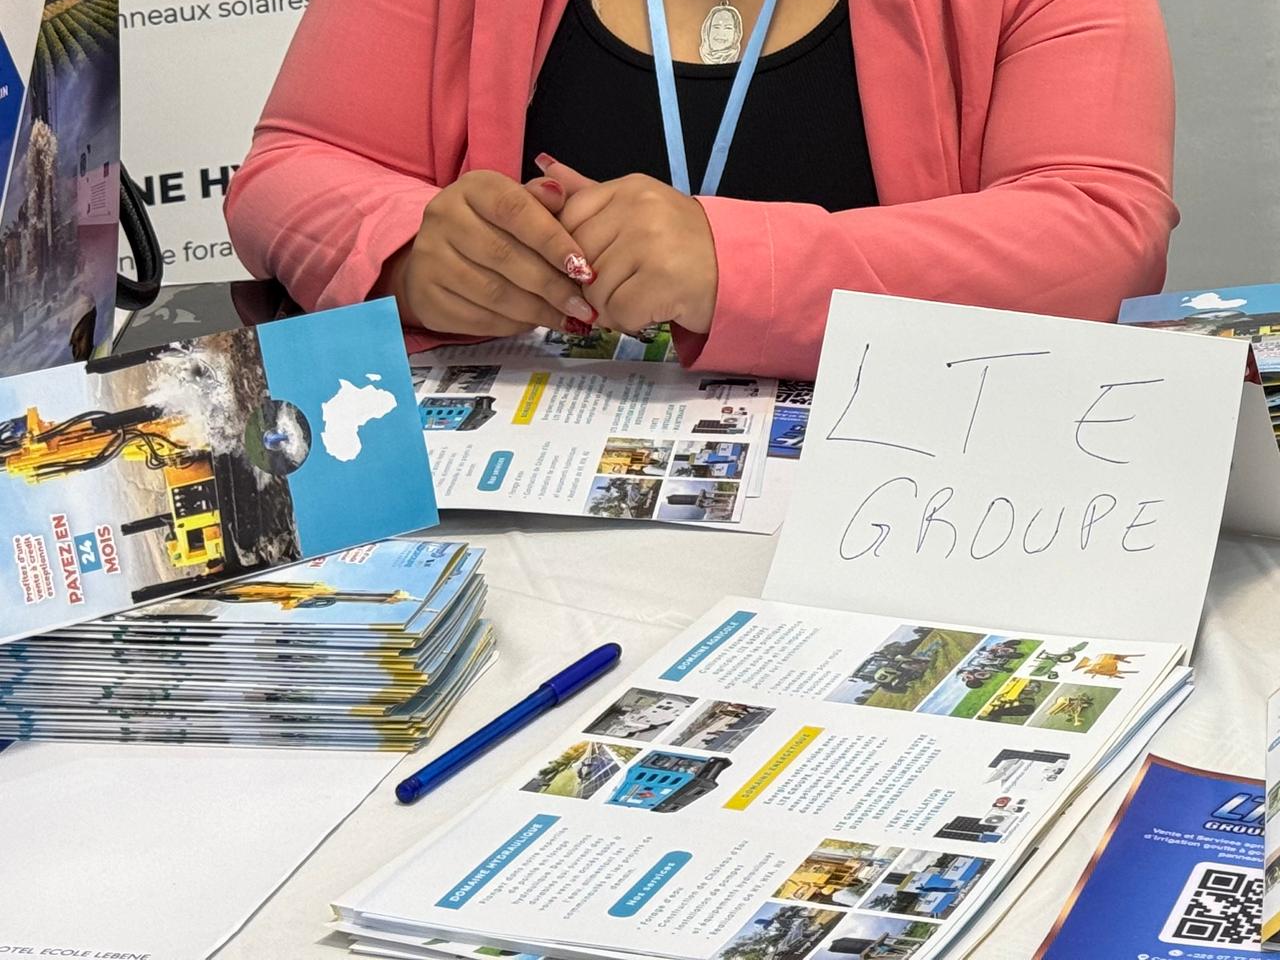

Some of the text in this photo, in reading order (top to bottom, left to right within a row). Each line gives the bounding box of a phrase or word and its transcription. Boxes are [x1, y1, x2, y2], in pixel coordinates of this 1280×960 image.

[838, 476, 1165, 561] GROUPE
[52, 515, 83, 604] PAYEZ EN
[79, 540, 95, 565] 24
[98, 526, 119, 573] MOIS
[33, 574, 45, 600] vente
[676, 621, 740, 671] DOMAINE AGRICOLE
[742, 771, 771, 798] DOMAINE
[885, 809, 909, 828] VENTE
[900, 788, 943, 830] INSTALLATION
[1203, 820, 1265, 837] GROU
[449, 869, 490, 902] DOMAINE
[487, 823, 543, 869] HYDRAULIQUE
[625, 862, 676, 906] Nos services
[40, 948, 93, 958] ECOLE
[94, 952, 151, 960] LEBENE
